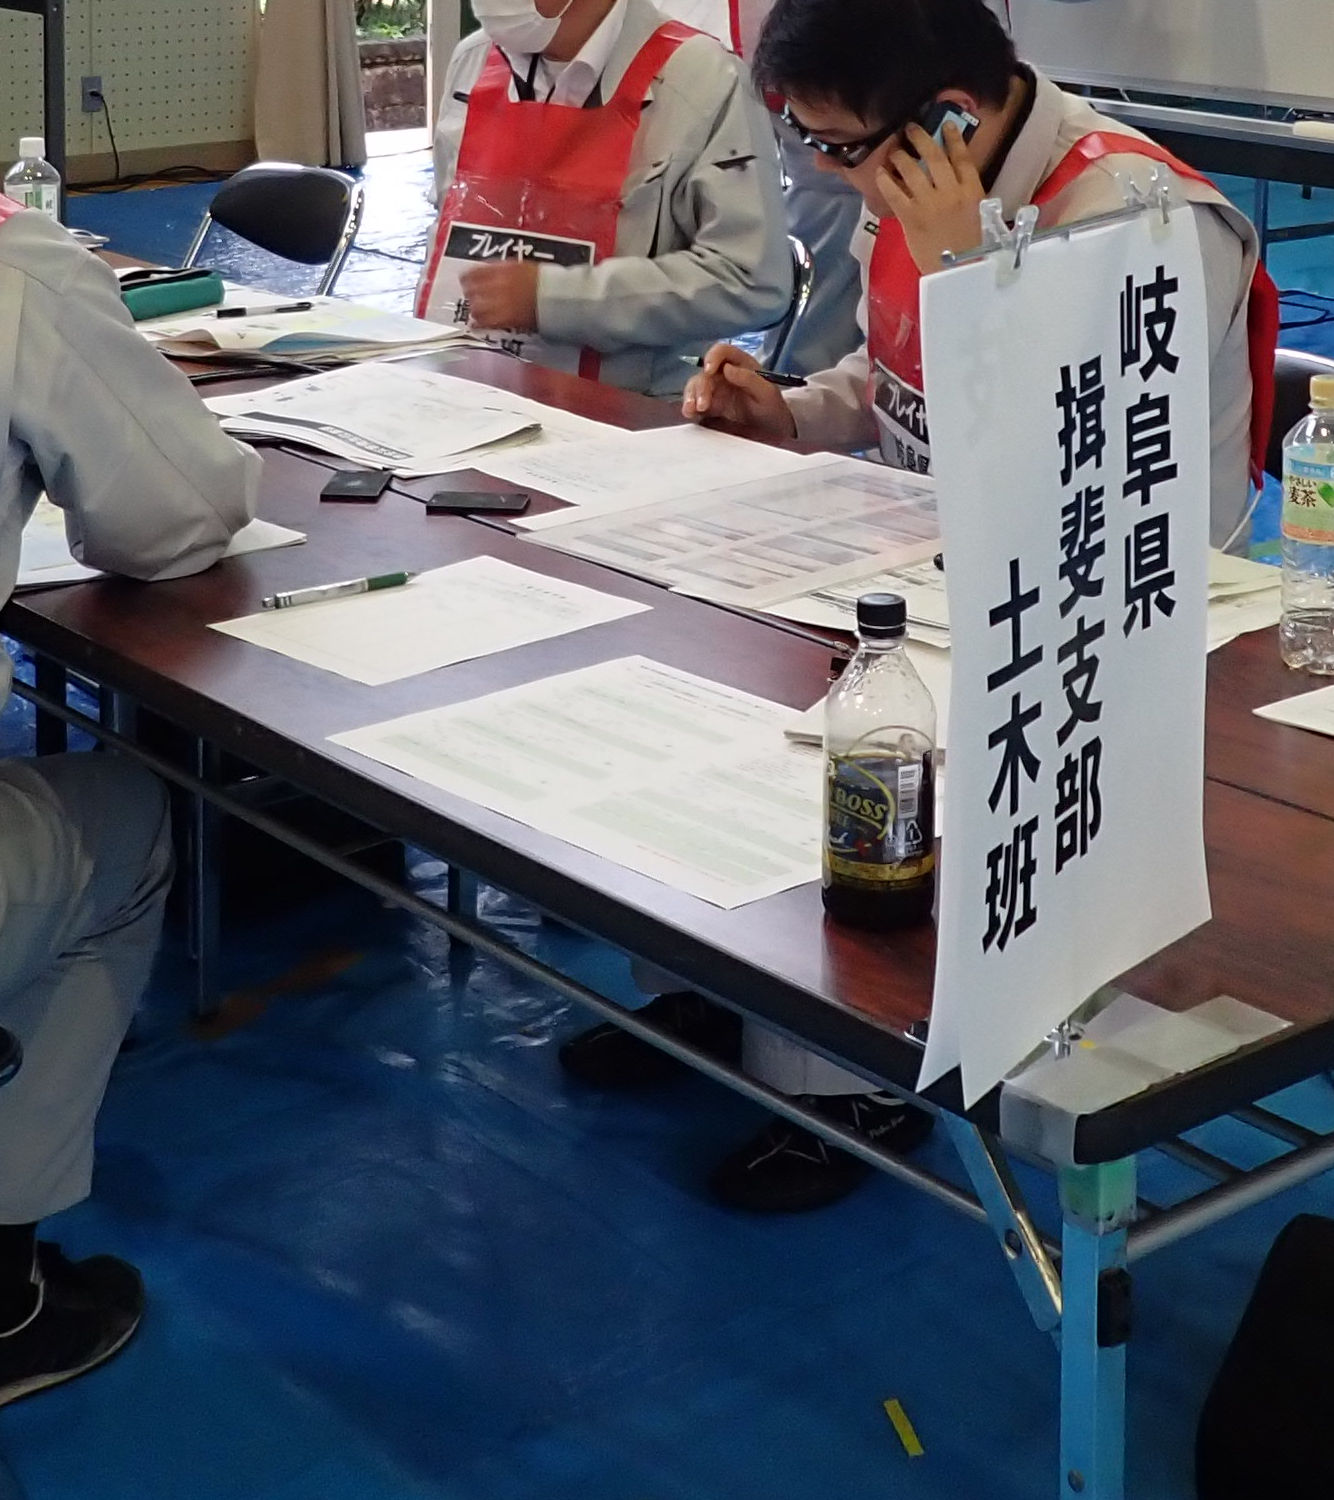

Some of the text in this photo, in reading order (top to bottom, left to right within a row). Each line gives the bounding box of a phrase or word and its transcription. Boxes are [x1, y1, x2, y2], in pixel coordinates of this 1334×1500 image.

[1054, 353, 1106, 878] 揖斐支部
[1119, 264, 1180, 639] 岐阜県
[835, 787, 889, 821] BOSS
[982, 559, 1044, 956] 土木班
